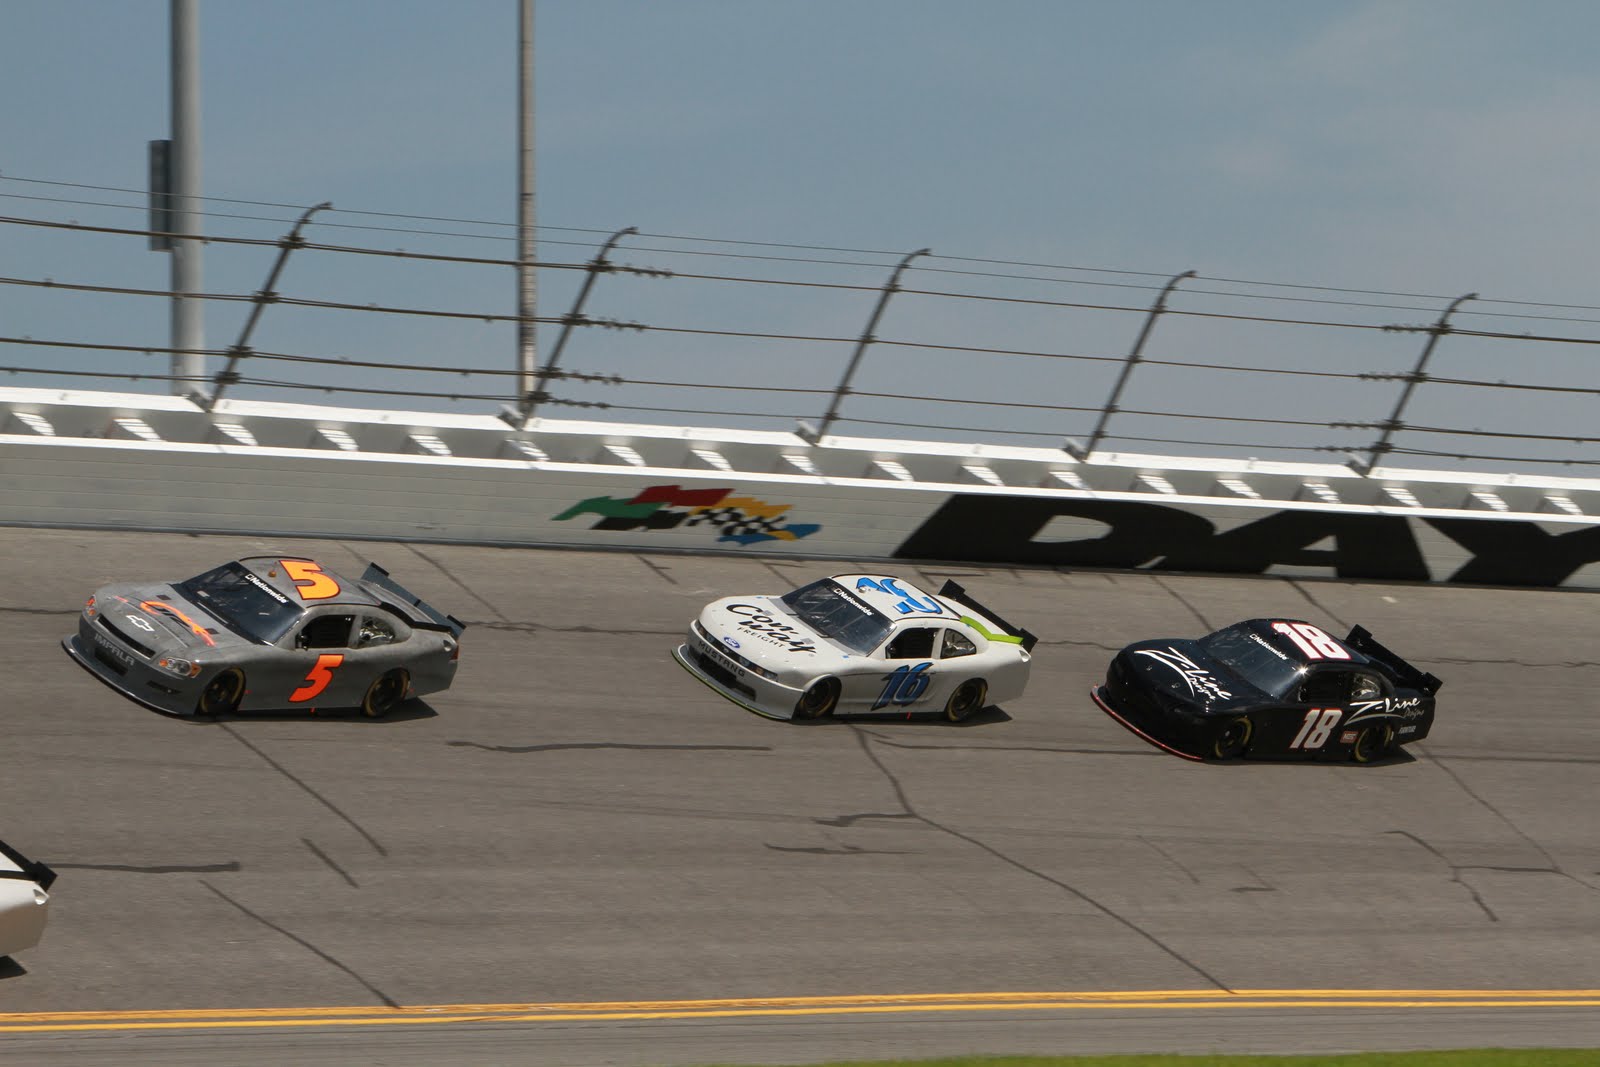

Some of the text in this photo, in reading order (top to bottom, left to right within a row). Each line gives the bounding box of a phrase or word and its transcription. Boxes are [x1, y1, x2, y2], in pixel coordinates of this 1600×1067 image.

[250, 576, 289, 604] Nationwide
[279, 560, 341, 600] 5
[839, 588, 873, 617] Nationwide
[94, 633, 136, 666] IMPALA
[737, 627, 786, 649] FREIGHT
[1254, 636, 1288, 661] Nationwide
[1270, 621, 1352, 660] 18
[288, 653, 345, 703] 5
[698, 641, 746, 678] MUSTANG
[871, 661, 934, 711] 16
[1289, 707, 1343, 749] 18
